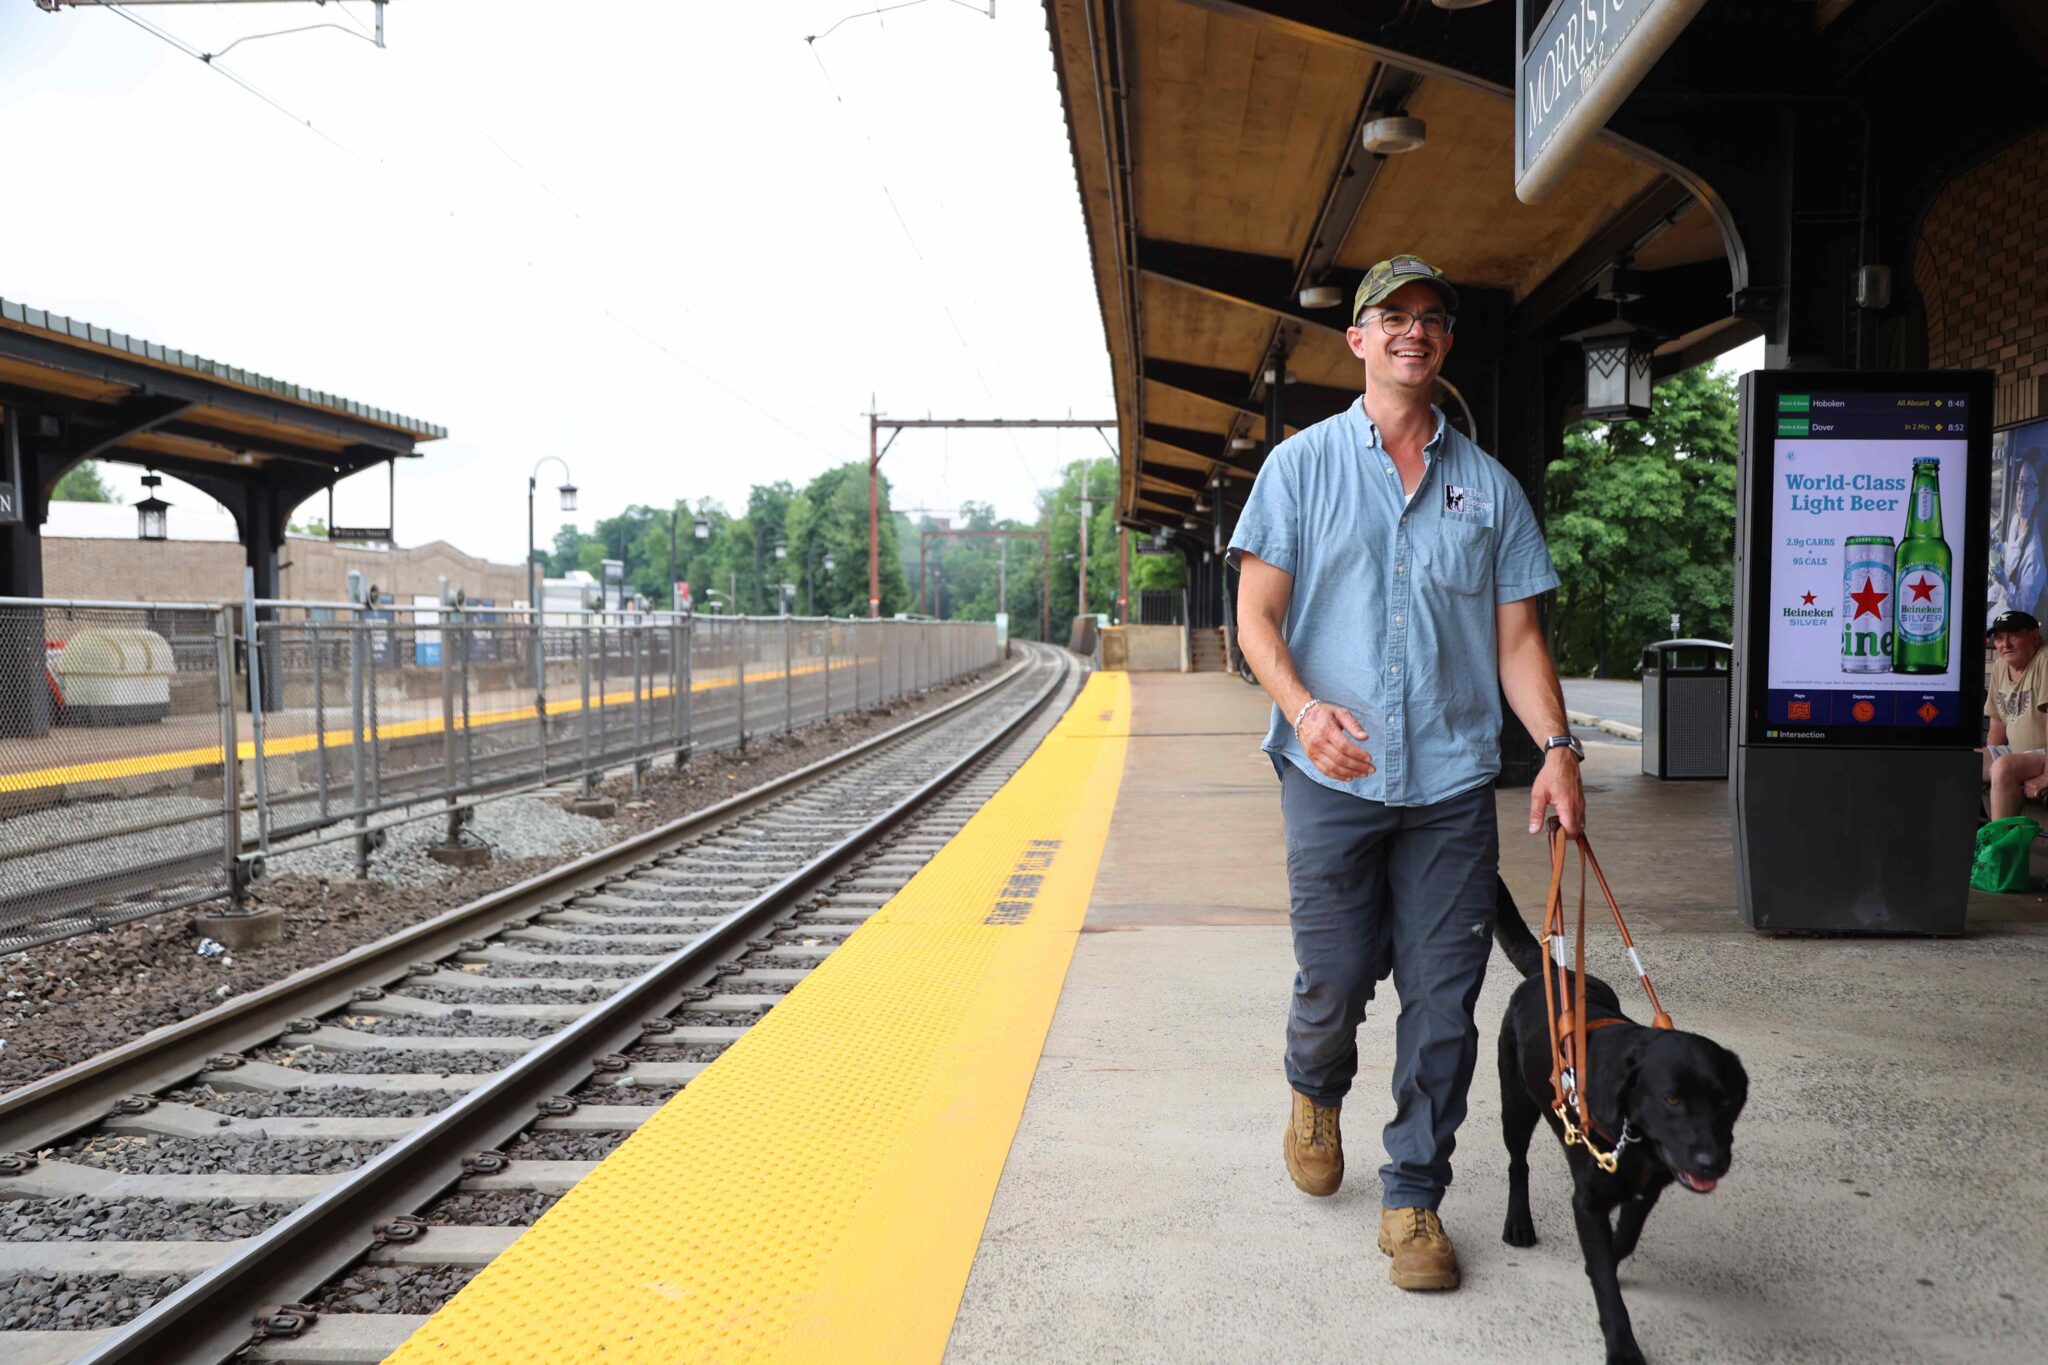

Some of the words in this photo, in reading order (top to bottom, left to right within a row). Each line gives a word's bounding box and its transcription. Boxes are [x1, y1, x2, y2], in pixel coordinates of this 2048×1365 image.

[1528, 0, 1625, 138] MORRIS
[1812, 400, 1845, 408] Hoboken
[1947, 400, 1965, 408] 8:48
[1812, 423, 1834, 431] Dover
[1947, 424, 1965, 432] 8:52
[1785, 474, 1906, 491] World-Class
[1791, 495, 1844, 515] Light
[1850, 495, 1899, 512] Beer
[1786, 538, 1805, 548] 2.9g
[1806, 538, 1835, 546] CARBS
[1792, 558, 1803, 566] 95
[1804, 558, 1828, 566] CALS
[1783, 607, 1834, 618] Heineken
[1901, 605, 1943, 614] Heineken
[1900, 614, 1943, 622] SILVER
[1779, 730, 1826, 739] Intersection
